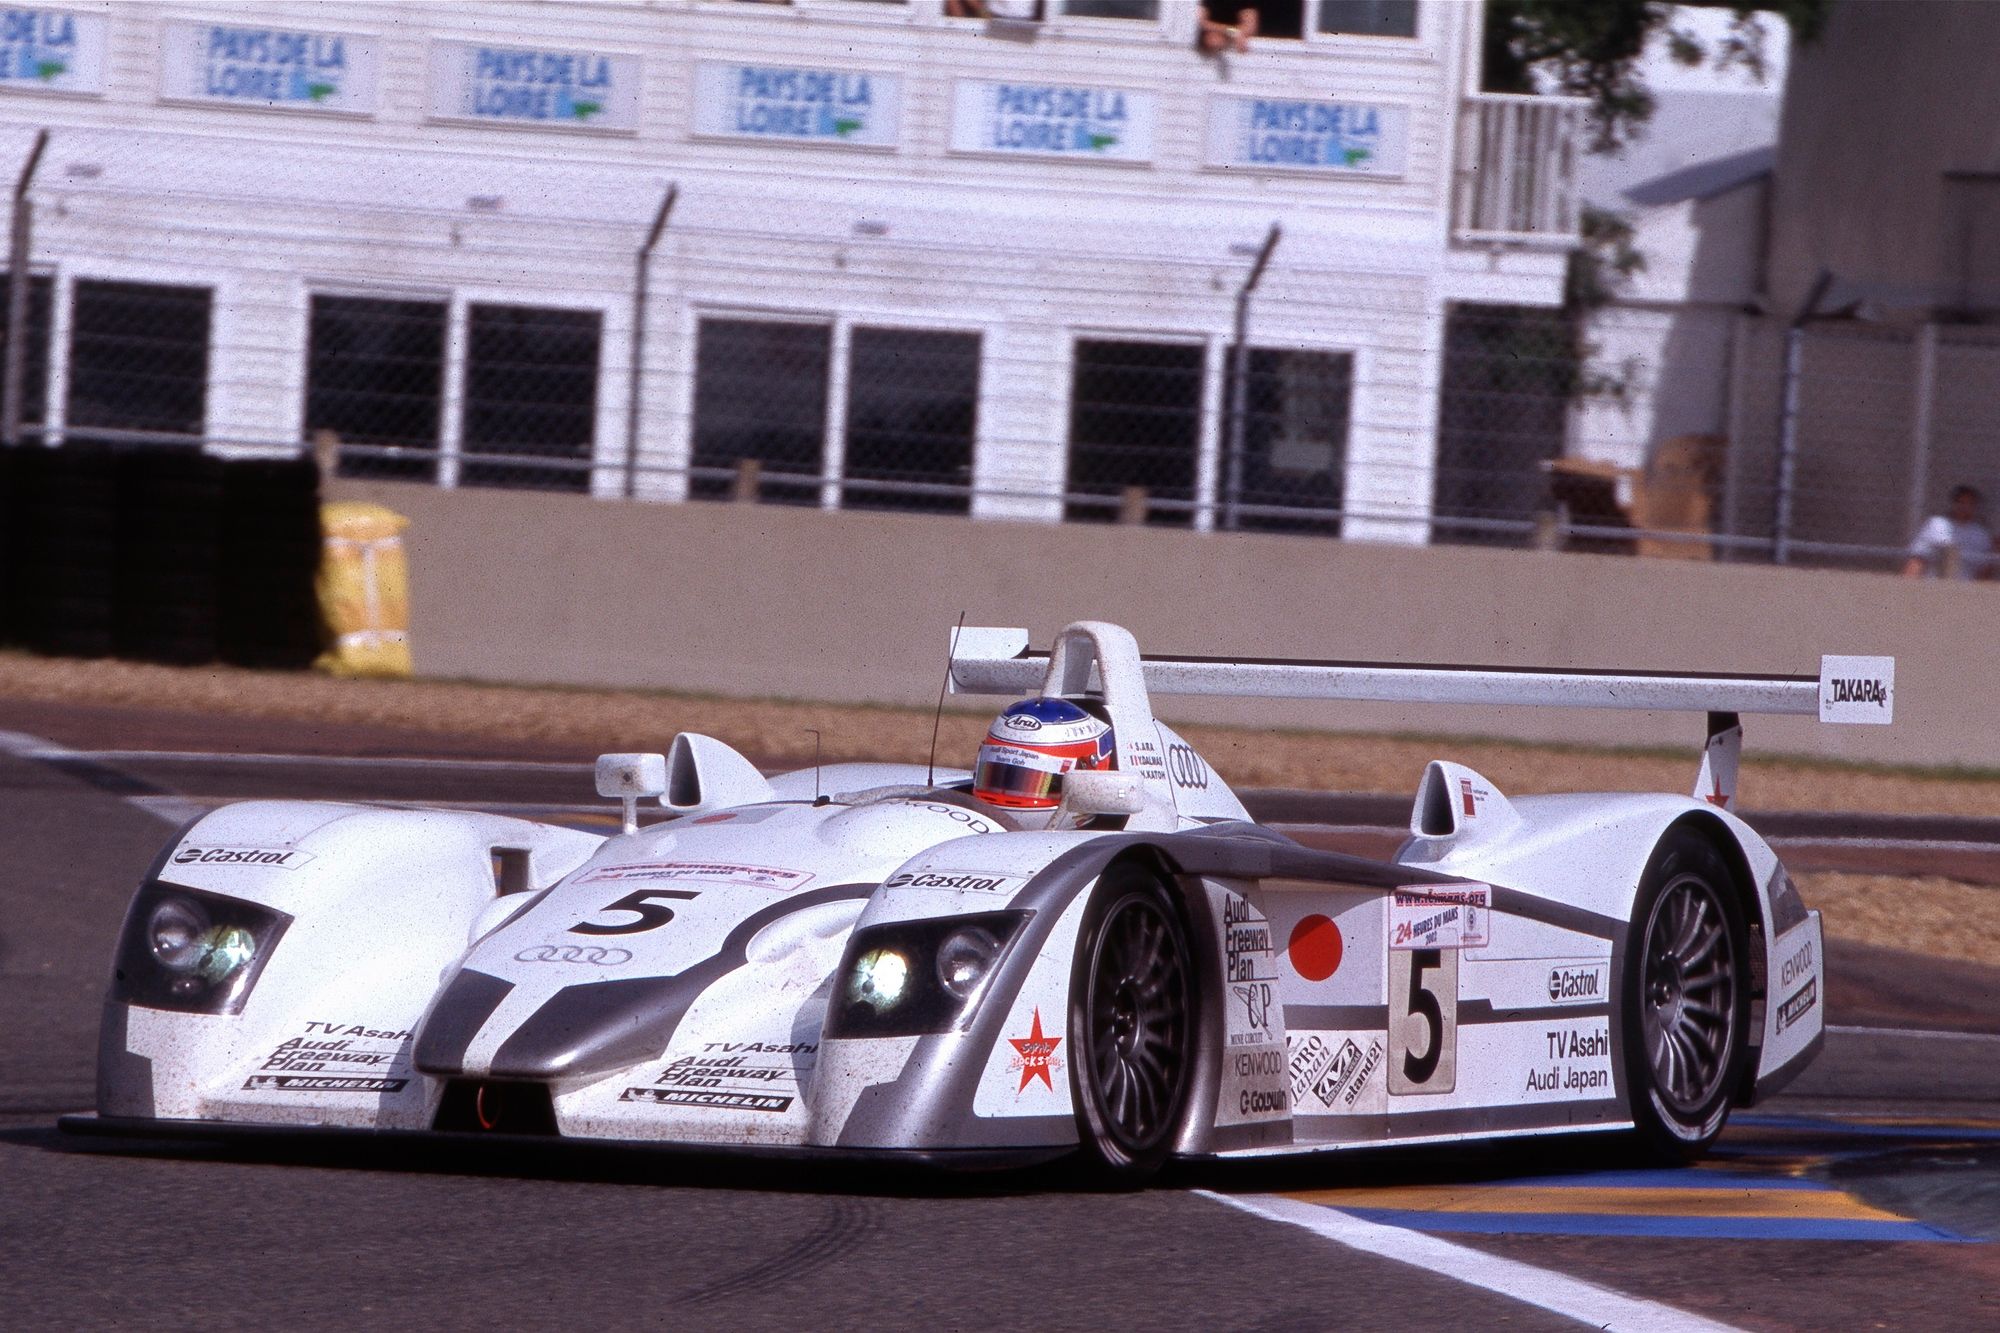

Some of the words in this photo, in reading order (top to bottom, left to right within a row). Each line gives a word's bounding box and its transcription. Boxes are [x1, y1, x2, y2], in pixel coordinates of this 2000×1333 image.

[207, 63, 281, 99] LOIRE
[475, 84, 548, 118] LOIRE
[737, 103, 810, 134] LOIRE
[995, 120, 1065, 150] LOIRE
[1250, 133, 1319, 164] LOIRE
[1831, 679, 1880, 703] TAKARA
[1010, 716, 1036, 727] Arai
[200, 849, 294, 864] Castrol
[911, 874, 1006, 891] Castrol
[567, 889, 702, 935] 5
[1224, 893, 1249, 923] Audi
[1396, 920, 1412, 944] 24
[1413, 917, 1434, 938] HEURES
[1434, 912, 1442, 929] DU
[1443, 907, 1458, 925] MANS
[1225, 922, 1269, 958] Freeway
[1228, 951, 1254, 982] Plan
[1781, 941, 1813, 989] KENWOOD
[1561, 969, 1599, 998] Castrol
[1403, 948, 1443, 1084] 5
[277, 1037, 353, 1051] Audi
[305, 1021, 345, 1035] TV
[342, 1025, 414, 1041] Asah
[1547, 1031, 1567, 1059] TV
[1568, 1029, 1608, 1058] Asahi
[268, 1050, 390, 1066] Freeway
[703, 1042, 746, 1053] TV
[260, 1058, 326, 1071] Plan
[662, 1065, 788, 1082] Freeway
[671, 1056, 747, 1068] Audi
[1235, 1050, 1282, 1078] KENWOOD
[284, 1078, 400, 1089] MICHELIN
[655, 1074, 722, 1087] Plan
[1526, 1067, 1559, 1091] Audi
[1564, 1066, 1608, 1093] Japan
[664, 1092, 785, 1108] MICHELIN
